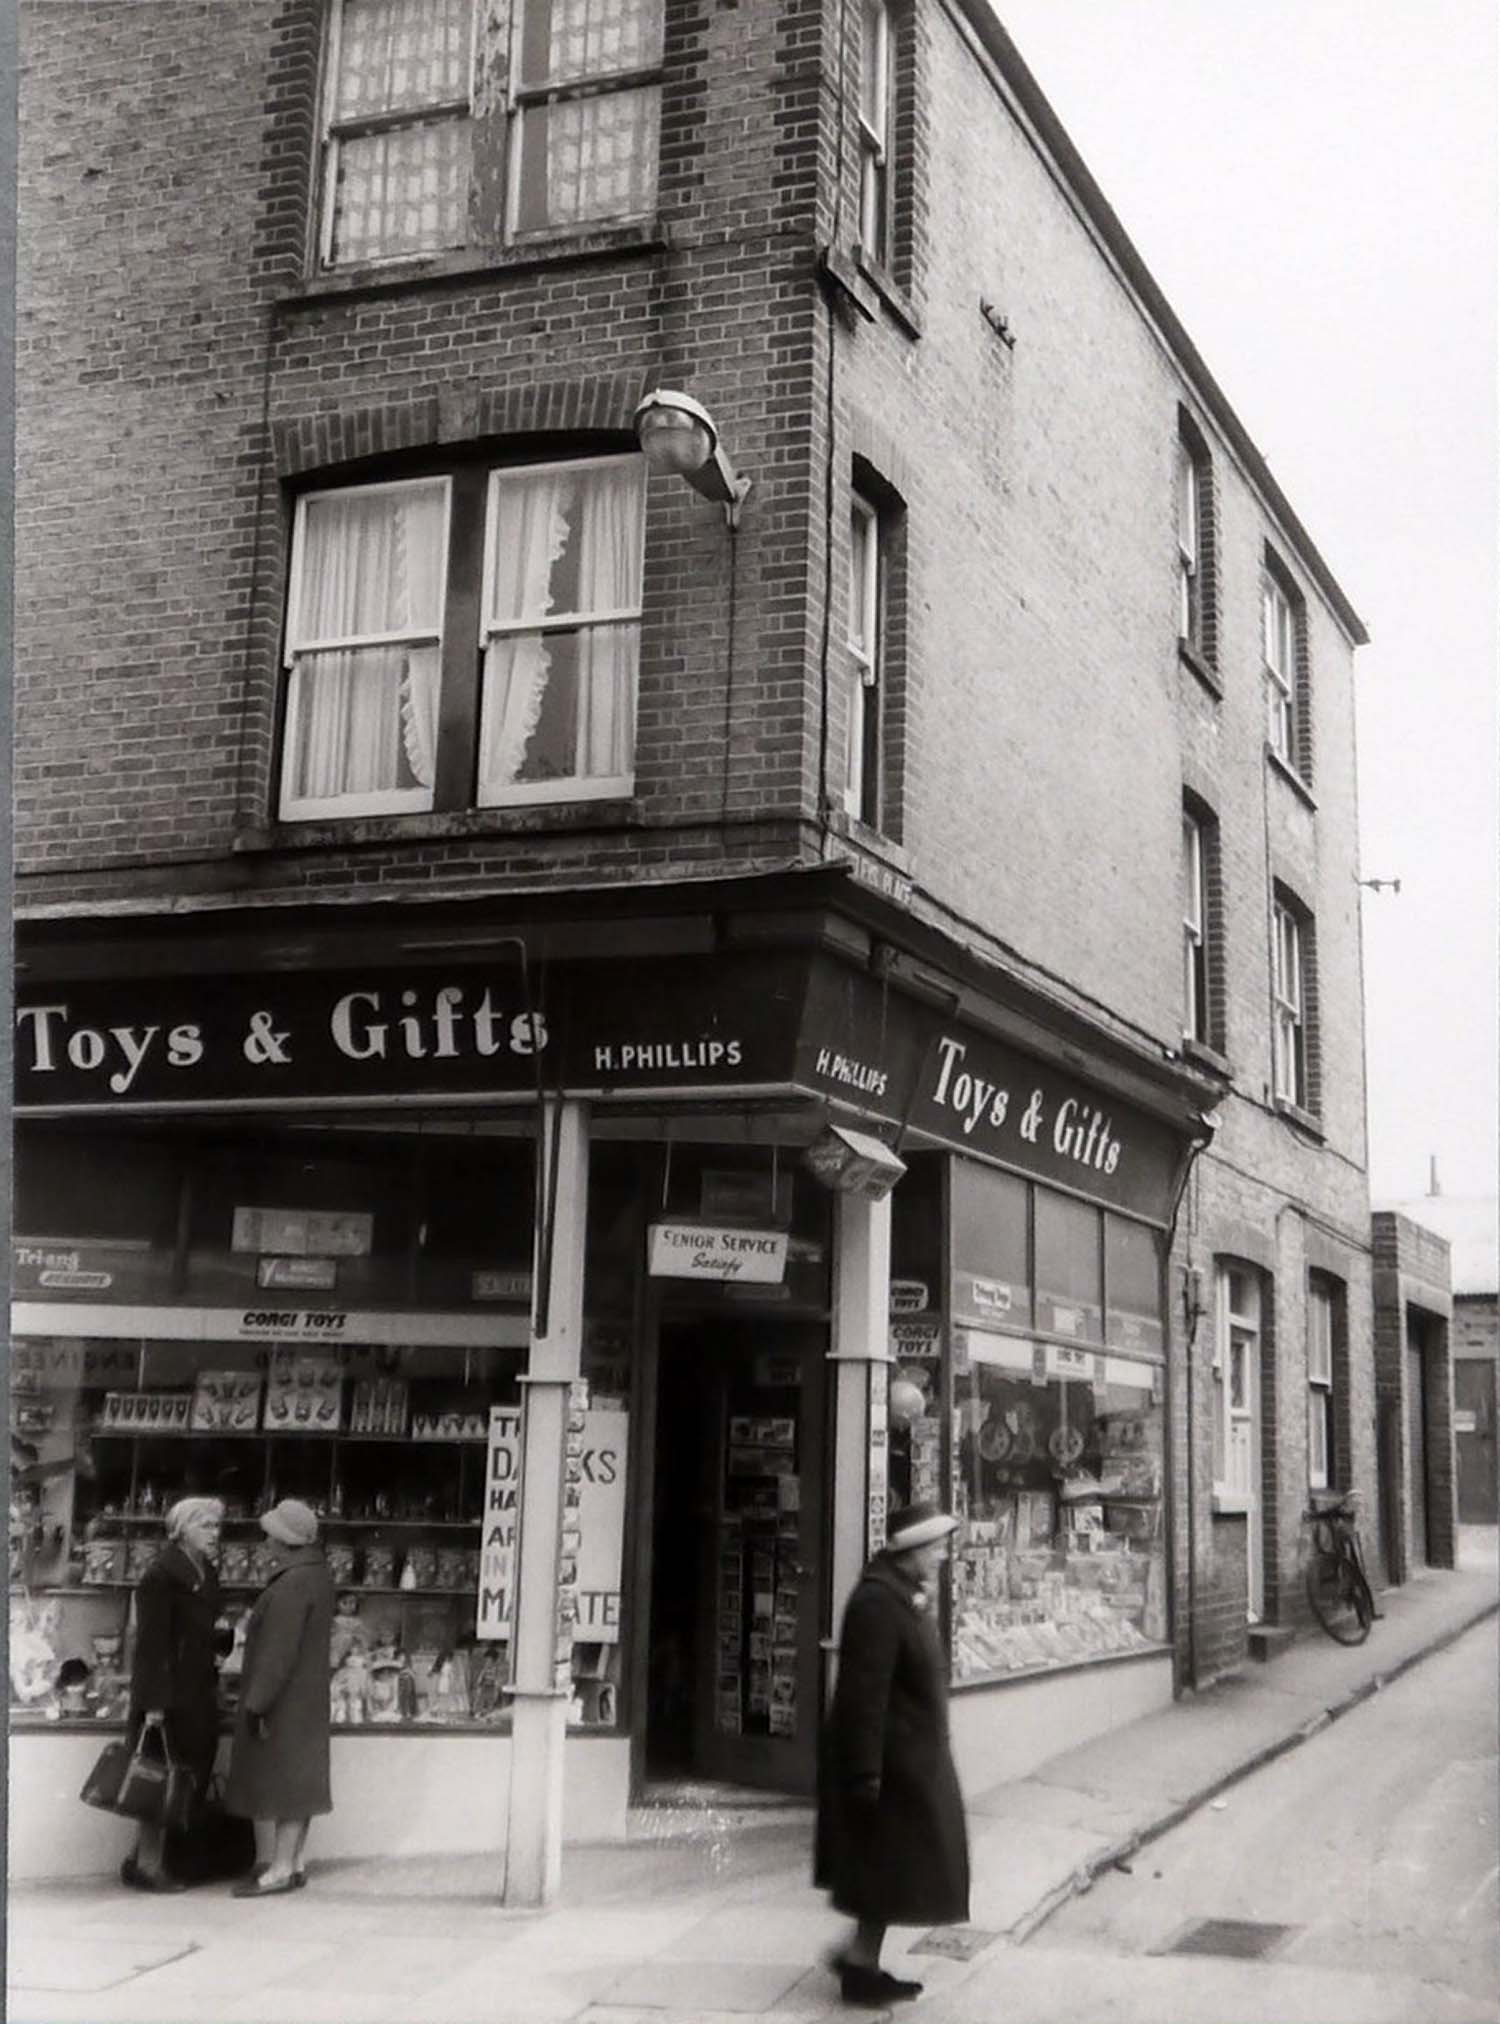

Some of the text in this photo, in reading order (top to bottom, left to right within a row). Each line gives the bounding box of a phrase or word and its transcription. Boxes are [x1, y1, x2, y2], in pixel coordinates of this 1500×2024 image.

[16, 987, 548, 1093] Toys & Gifts
[933, 1036, 1121, 1174] Toys & Gifts
[721, 1234, 778, 1254] SERVICE
[243, 1311, 347, 1328] CORGI TOYS
[892, 1326, 940, 1340] CORGI
[897, 1340, 932, 1353] TOYS
